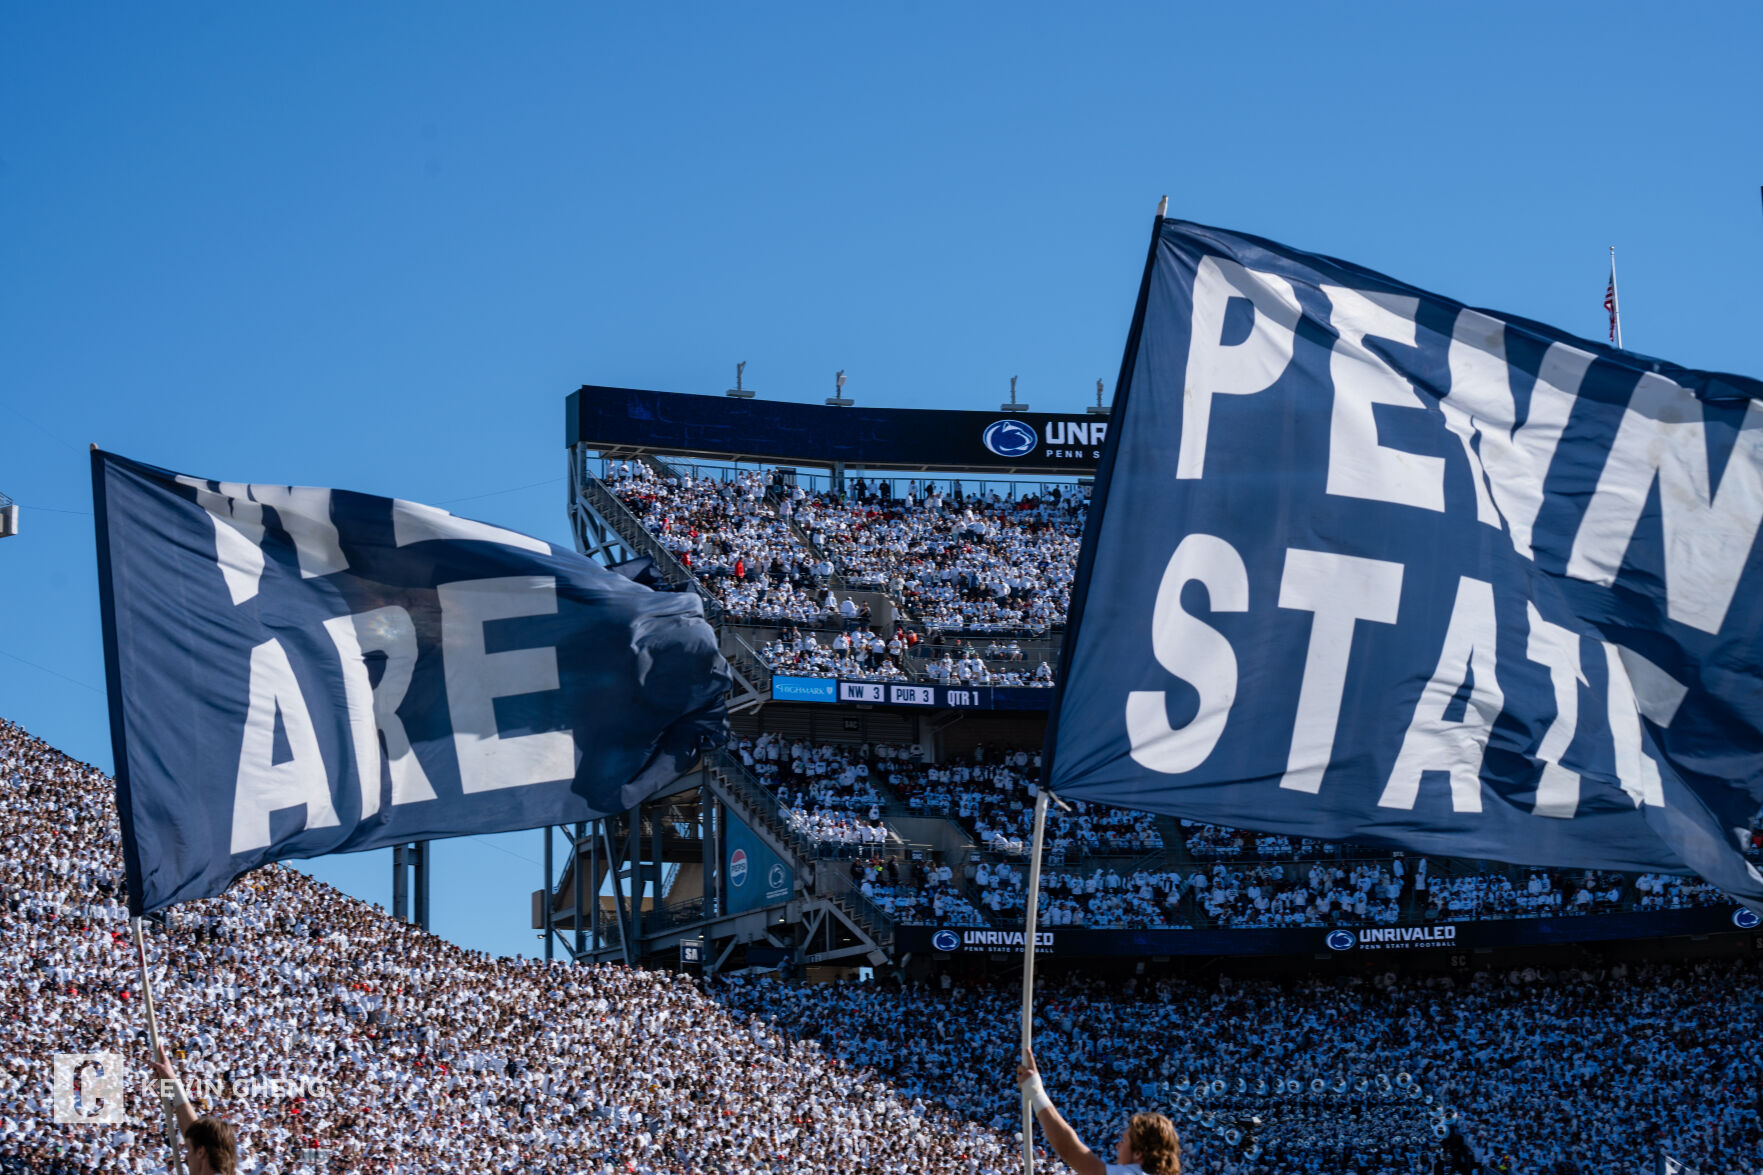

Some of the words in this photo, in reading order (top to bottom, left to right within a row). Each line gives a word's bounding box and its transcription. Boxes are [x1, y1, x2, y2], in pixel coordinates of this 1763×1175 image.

[1176, 254, 1763, 636] PENN
[1046, 450, 1083, 458] PENN
[848, 685, 864, 698] NW
[873, 687, 880, 700] 3
[896, 688, 915, 702] PUR
[923, 690, 929, 703] 3
[947, 690, 970, 707] QTR
[972, 691, 979, 706] 1
[230, 576, 576, 855] ARE
[1360, 926, 1456, 942] UNRIVALED
[685, 947, 698, 960] SA
